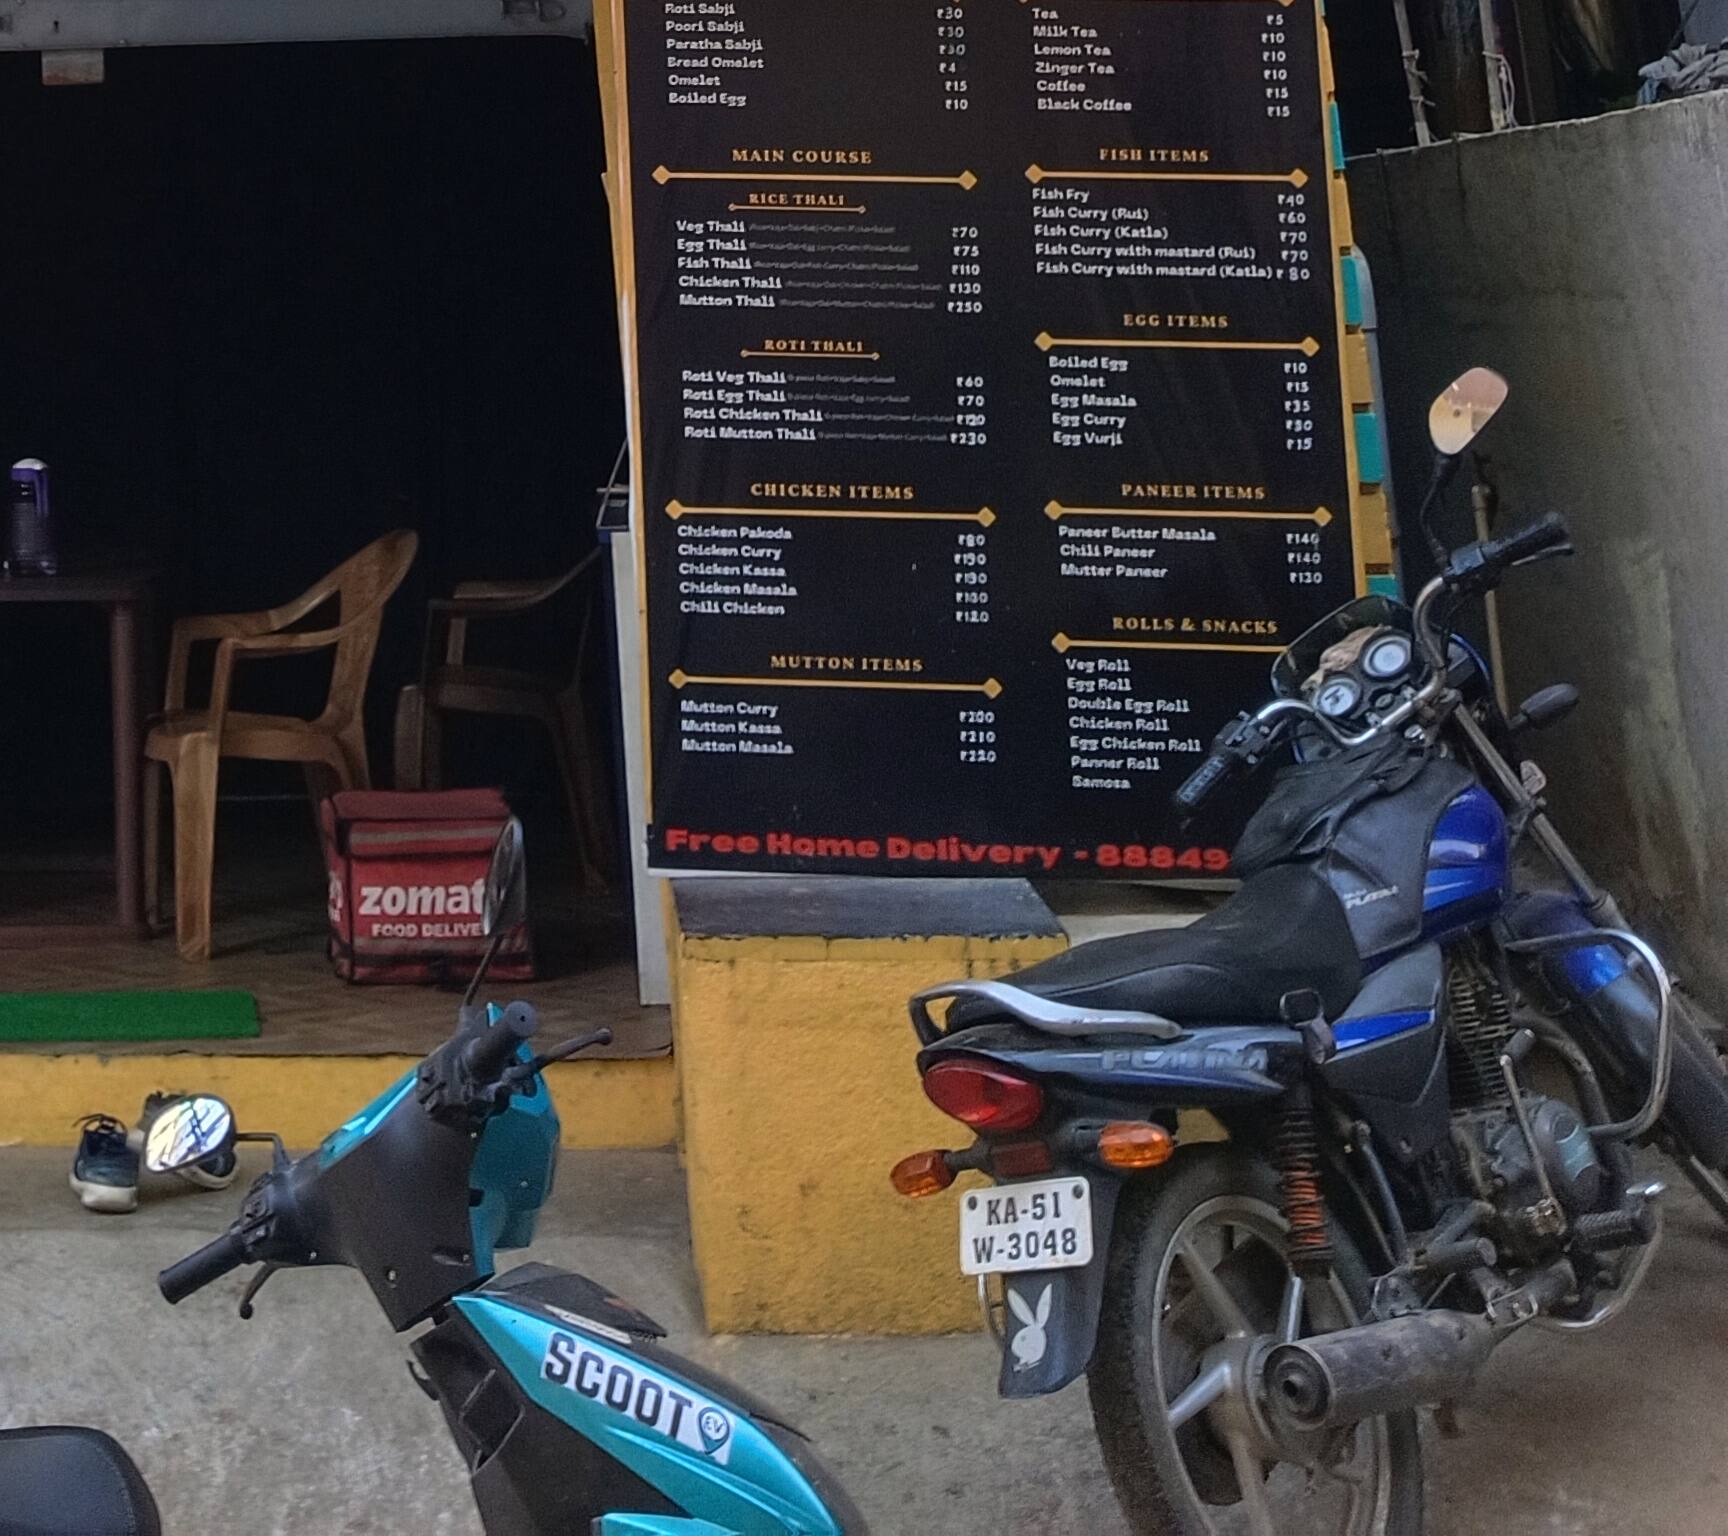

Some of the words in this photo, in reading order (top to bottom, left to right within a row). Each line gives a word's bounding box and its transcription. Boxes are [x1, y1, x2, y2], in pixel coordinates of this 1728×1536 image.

[665, 3, 695, 15] Roti
[698, 3, 735, 16] Sabji
[1032, 8, 1058, 19] Tea
[666, 21, 704, 32] Poori
[708, 21, 744, 34] Sabji
[1034, 26, 1068, 37] Milk
[1071, 26, 1098, 38] Tea
[1034, 44, 1081, 56] Lemon
[1084, 45, 1112, 56] Tea
[667, 58, 708, 68] Bread
[712, 58, 764, 68] Omelet
[1036, 62, 1084, 76] Zinger
[1088, 63, 1114, 74] Tea
[668, 76, 720, 86] Omelet
[1037, 80, 1086, 92] Coffee
[669, 93, 716, 104] Boiled
[720, 94, 746, 107] Egg
[1038, 99, 1079, 110] Black
[1084, 100, 1132, 112] Coffee
[732, 149, 784, 162] MAIN
[793, 150, 872, 164] COURSE
[1100, 148, 1142, 160] FISH
[1150, 150, 1209, 162] ITEMS
[749, 193, 788, 205] RICE
[793, 194, 844, 206] THALI
[1033, 189, 1064, 199] Fish
[1067, 189, 1089, 202] Fry
[676, 221, 703, 234] Veg
[707, 221, 745, 232] Thali
[677, 239, 704, 252] Egg
[708, 239, 746, 251] Thali
[677, 258, 709, 269] Fish
[714, 258, 752, 270] Thali
[678, 276, 739, 288] Chicken
[743, 277, 781, 289] Thali
[680, 294, 732, 307] Mutton
[736, 295, 775, 307] Thali
[1124, 314, 1159, 326] EGG
[1168, 315, 1229, 328] ITEMS
[764, 339, 805, 351] ROTI
[811, 340, 863, 352] THALI
[1049, 357, 1097, 368] Boiled
[1101, 358, 1128, 372] Egg
[682, 371, 713, 382] Roti
[717, 372, 744, 384] Veg
[747, 371, 786, 383] Thali
[683, 390, 714, 401] Roti
[717, 390, 744, 403] Egg
[747, 390, 786, 402] Thali
[1051, 394, 1079, 408] Egg
[1082, 395, 1137, 407] Masala
[684, 408, 715, 420] Roti
[719, 409, 779, 421] Chicken
[783, 410, 822, 421] Thali
[1052, 413, 1079, 427] Egg
[1084, 414, 1126, 428] Curry
[684, 426, 715, 438] Roti
[720, 427, 773, 439] Mutton
[777, 428, 816, 440] Thali
[751, 483, 842, 498] CHICKEN
[849, 485, 915, 500] ITEMS
[1122, 483, 1196, 498] PANEER
[1204, 485, 1266, 499] ITEMS
[677, 525, 737, 538] Chicken
[740, 526, 792, 540] Pakoda
[678, 544, 738, 557] Chicken
[741, 545, 782, 561] Curry
[1113, 617, 1174, 631] ROLLS
[1181, 618, 1196, 631] &
[1202, 619, 1278, 634] SNACKS
[771, 655, 854, 670] MUTTON
[862, 658, 923, 672] ITEMS
[1066, 659, 1094, 673] Veg
[1098, 659, 1131, 672] Roll
[1067, 678, 1095, 692] Egg
[1098, 678, 1132, 691] Roll
[681, 700, 733, 714] Mutton
[737, 701, 778, 718] Curry
[1069, 697, 1121, 711] Double
[1125, 698, 1154, 714] Egg
[1157, 700, 1189, 713] Roll
[1069, 717, 1132, 731] Chicken
[1136, 718, 1170, 732] Roll
[1070, 737, 1098, 751] Egg
[1102, 737, 1165, 751] Chicken
[1169, 739, 1202, 752] Roll
[665, 828, 760, 853] Free
[766, 832, 880, 859] Home
[886, 835, 1061, 870] Delivery
[1096, 845, 1232, 871] 88849
[359, 879, 485, 915] zomat
[372, 924, 417, 937] FOOD
[422, 923, 483, 937] DELIVE
[986, 1191, 1061, 1226] KA-51
[973, 1227, 1077, 1264] W-3048
[544, 1331, 693, 1440] SCOOT
